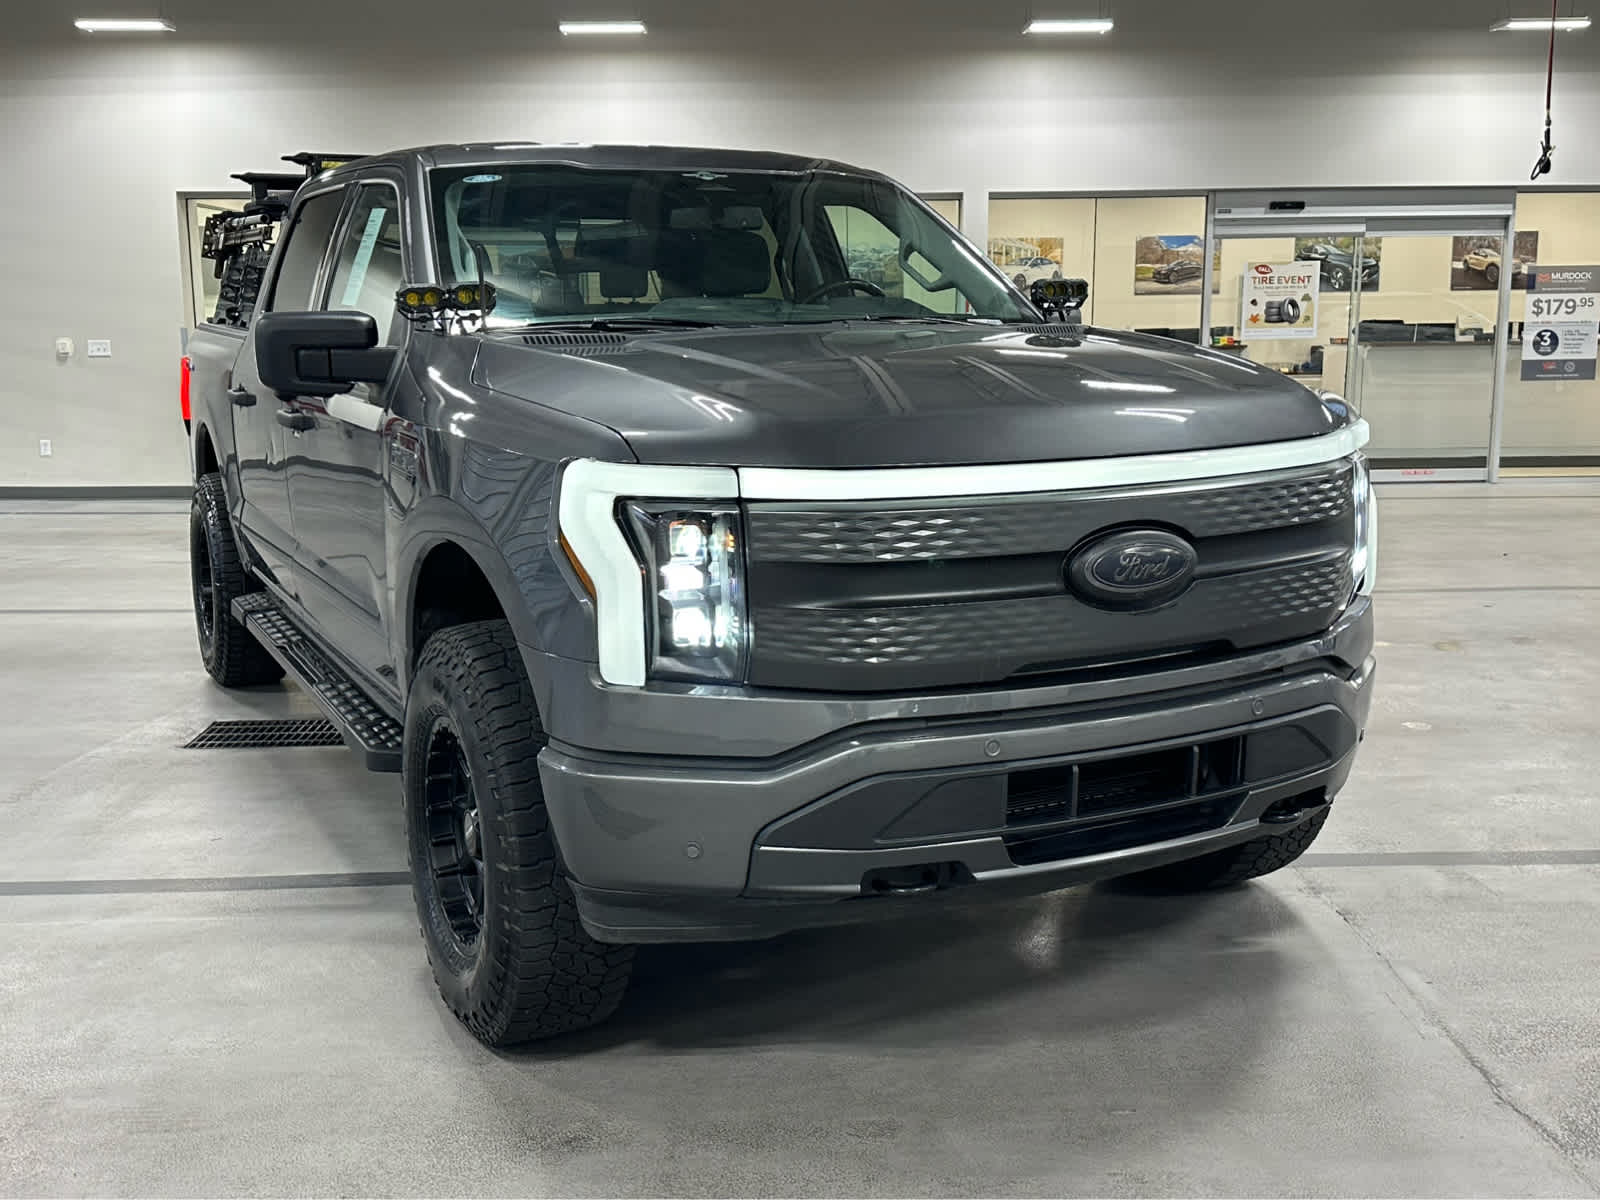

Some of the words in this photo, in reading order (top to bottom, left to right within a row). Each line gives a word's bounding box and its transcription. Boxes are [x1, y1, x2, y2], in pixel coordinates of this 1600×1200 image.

[1252, 275, 1275, 285] TIRE
[1277, 275, 1312, 285] EVENT
[1551, 271, 1592, 280] MURDOCK
[1540, 331, 1552, 346] 3
[1115, 553, 1170, 579] Ford
